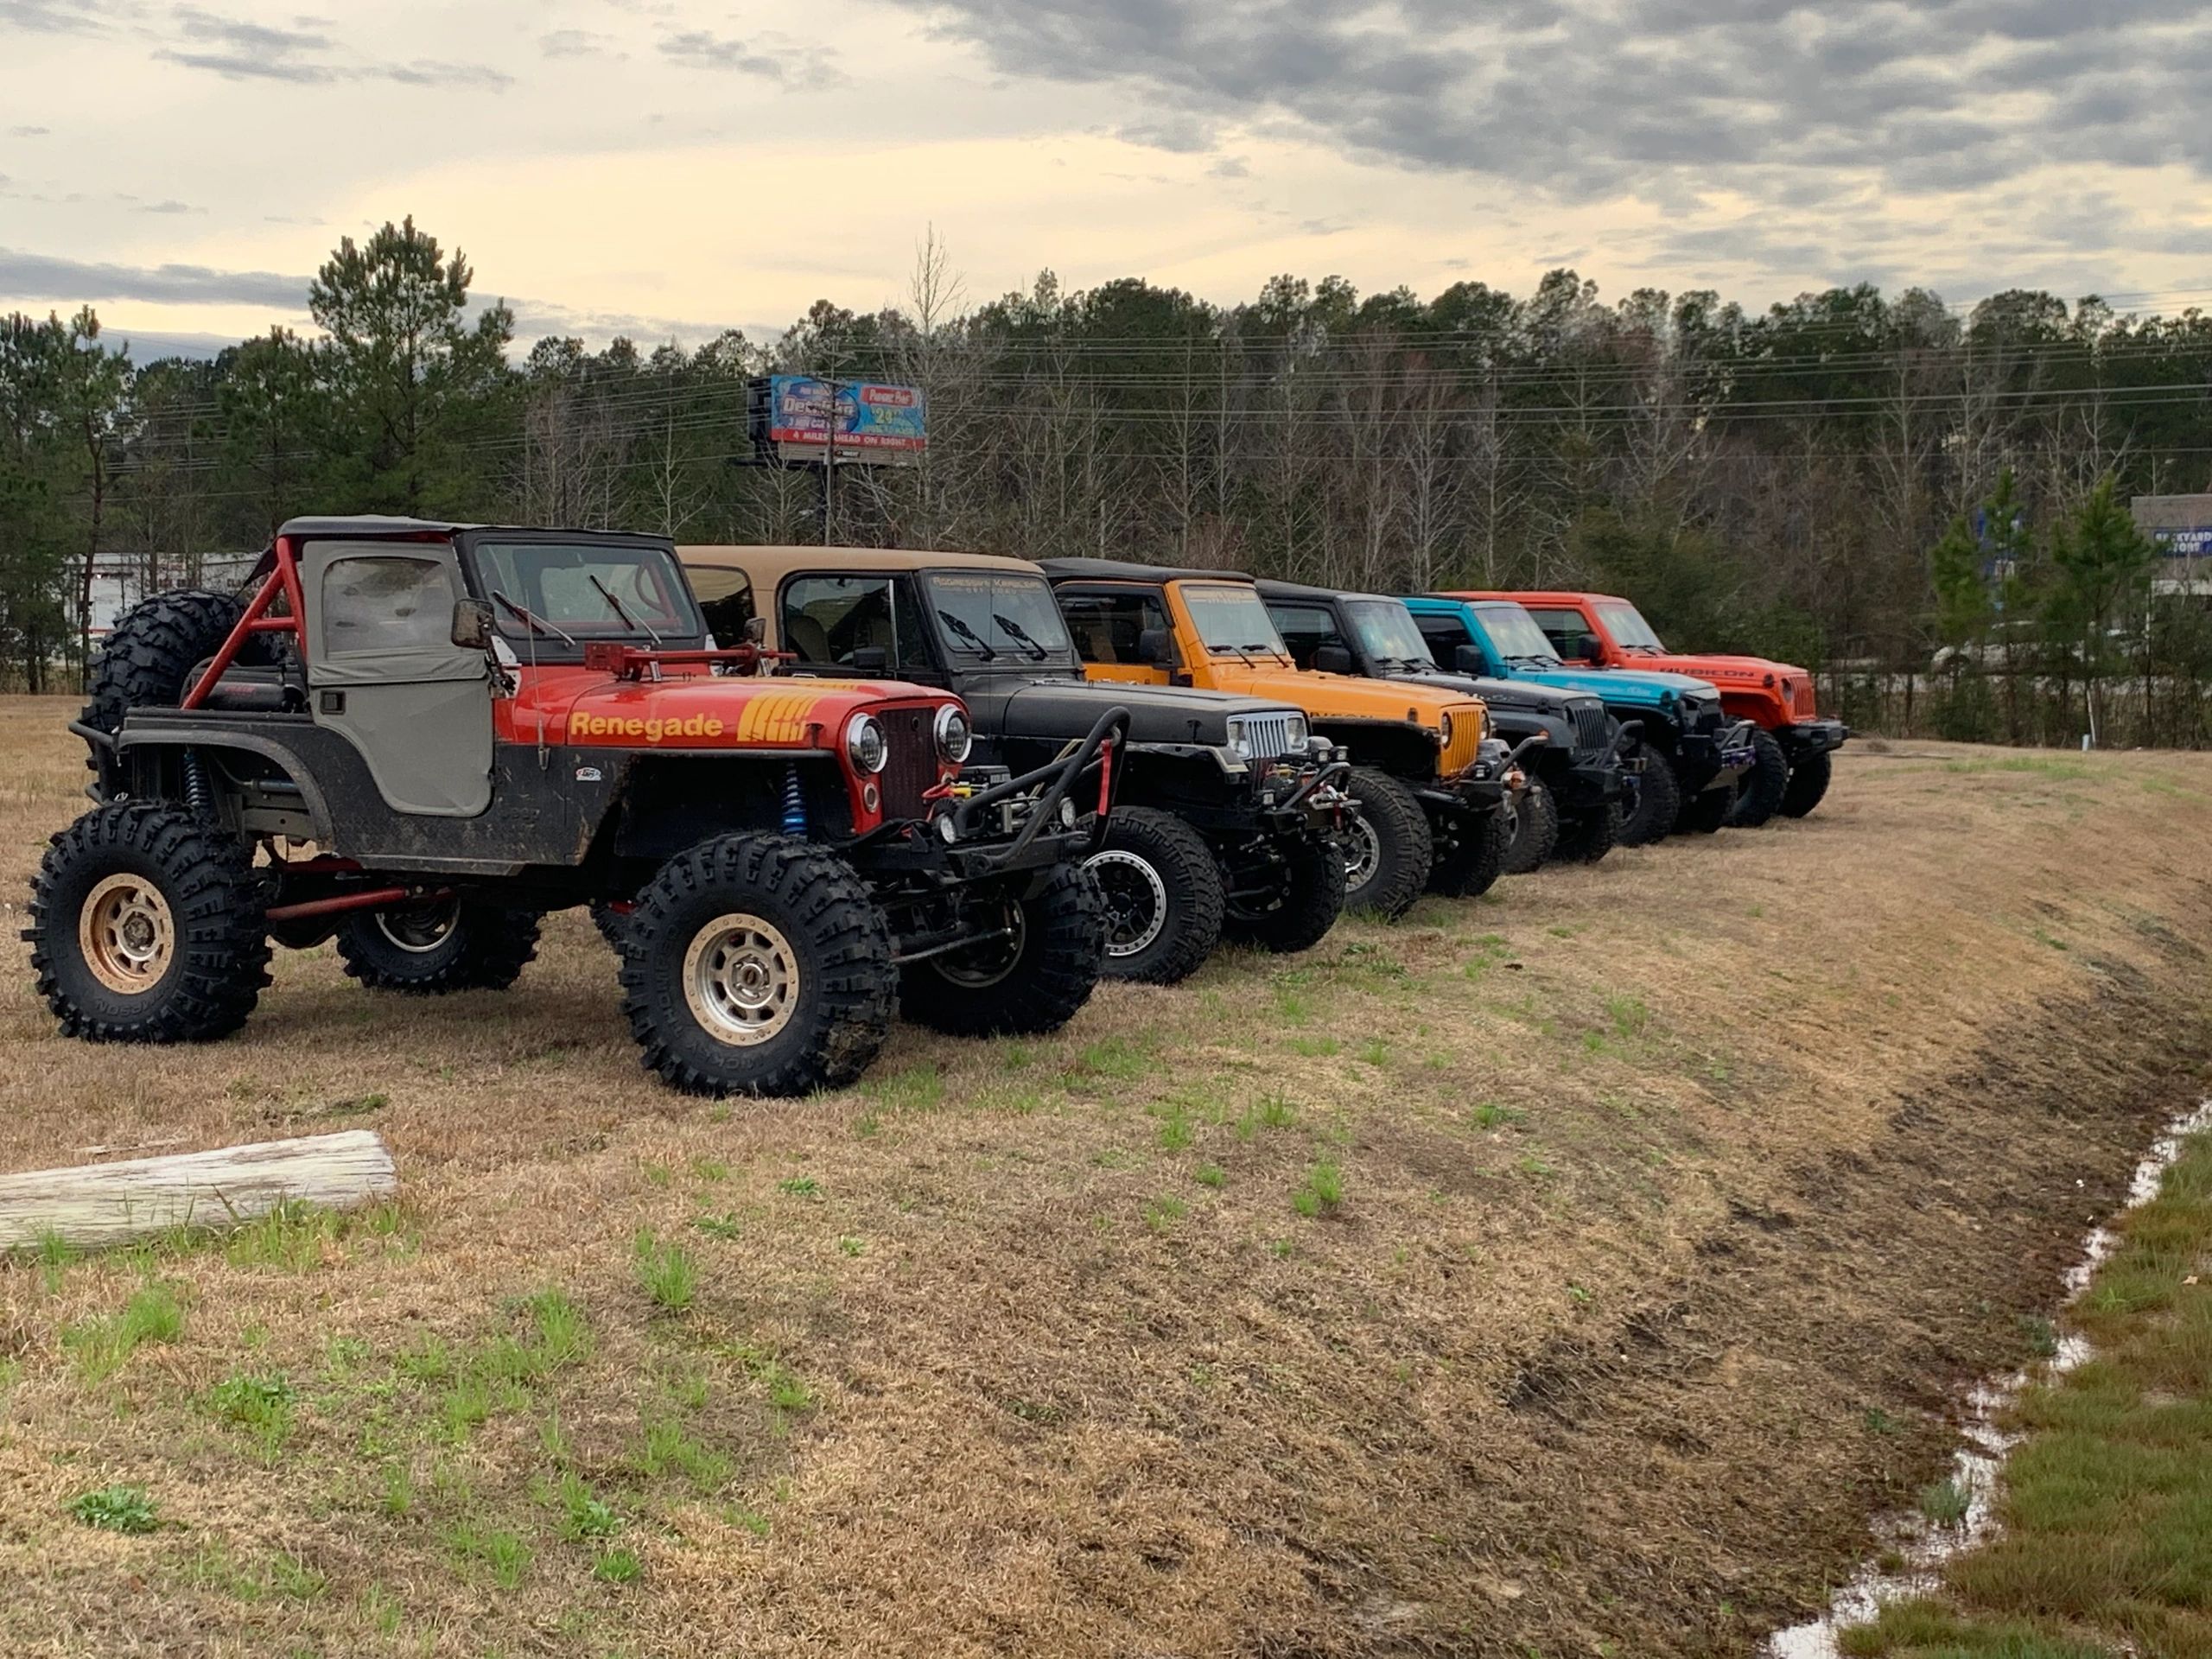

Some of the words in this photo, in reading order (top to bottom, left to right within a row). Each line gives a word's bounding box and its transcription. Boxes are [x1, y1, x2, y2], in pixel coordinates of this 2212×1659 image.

[803, 432, 829, 442] MILES
[834, 434, 861, 443] AHEAD
[864, 436, 878, 445] ON
[881, 437, 906, 447] RIGHT
[570, 712, 724, 741] Renegade
